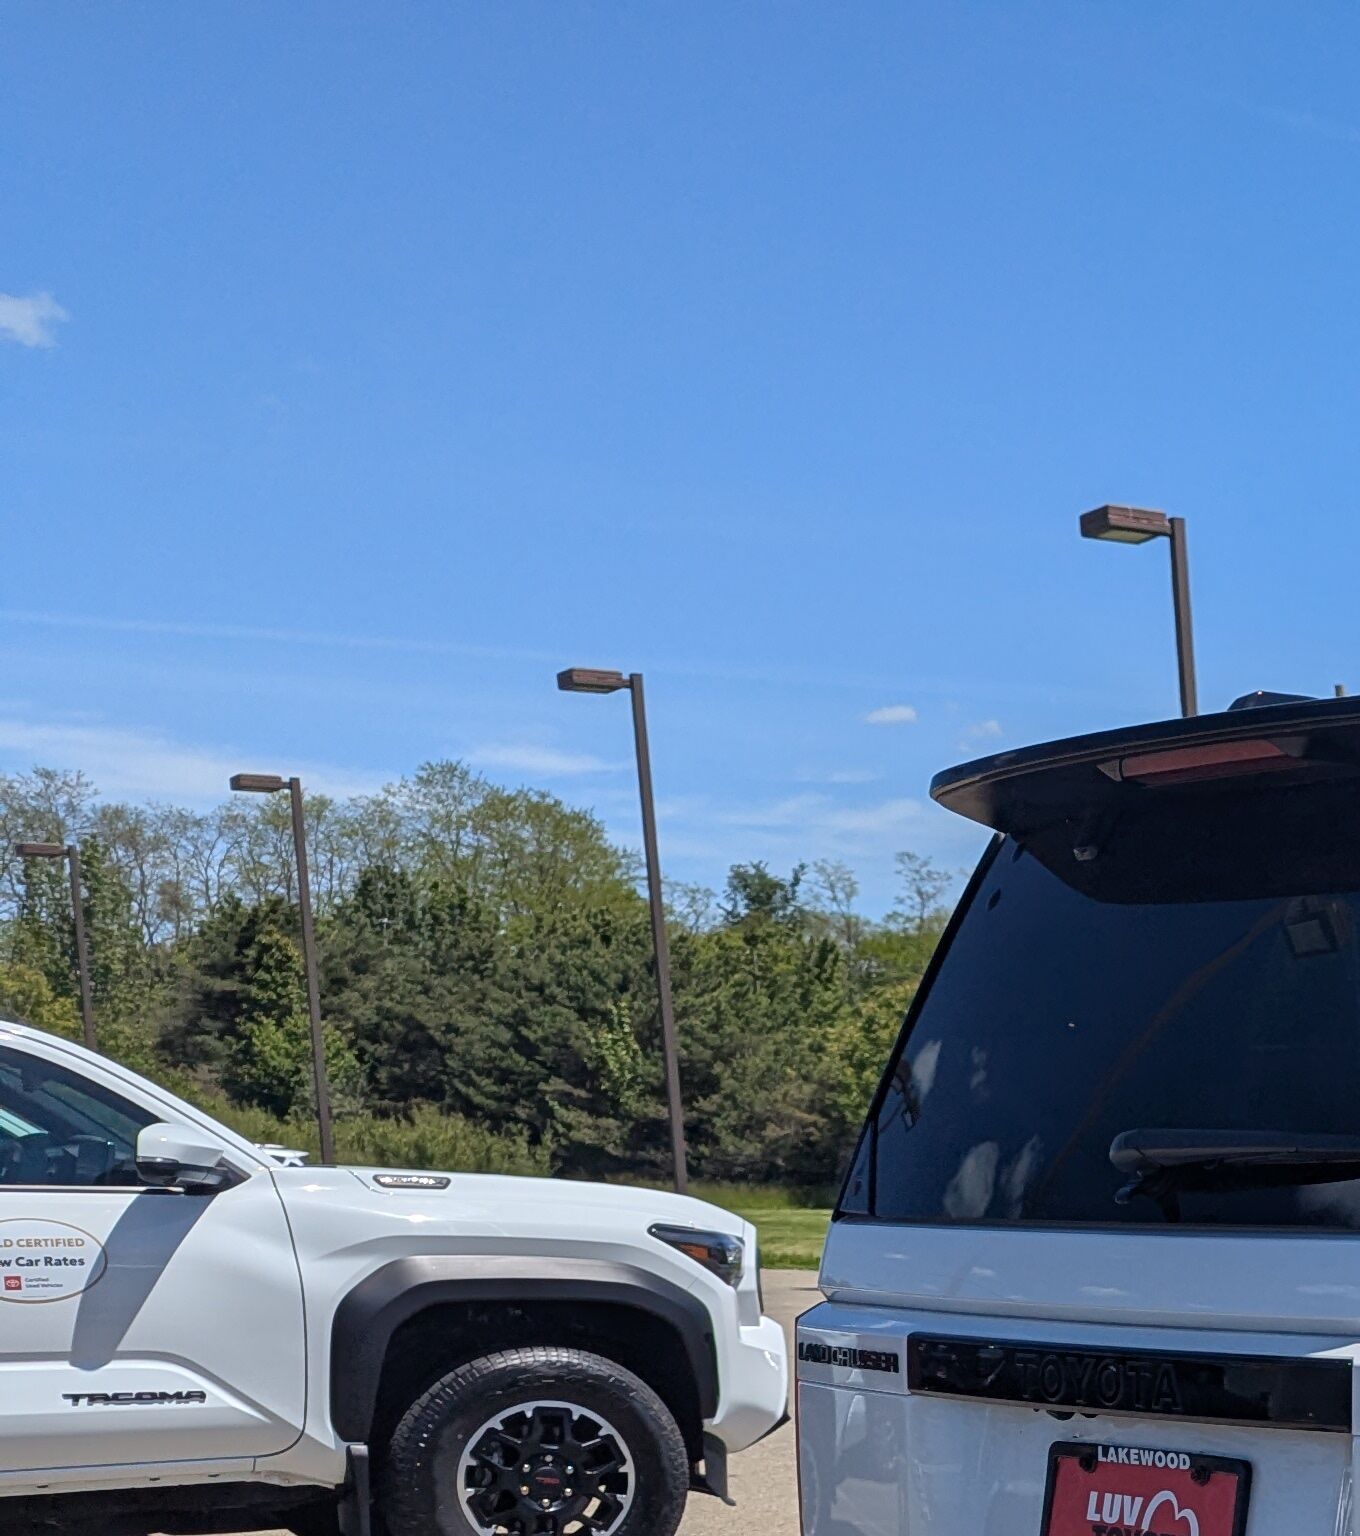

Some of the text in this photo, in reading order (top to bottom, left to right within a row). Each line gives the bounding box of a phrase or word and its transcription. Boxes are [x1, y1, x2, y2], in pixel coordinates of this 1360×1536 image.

[16, 1238, 85, 1248] CERTIFIED
[15, 1256, 41, 1267] Car
[44, 1256, 85, 1267] Rates
[1016, 1352, 1183, 1411] TOYOTA
[62, 1391, 206, 1406] TACOMA
[1097, 1446, 1191, 1470] LAKEWOOD
[1086, 1490, 1144, 1526] LUV
